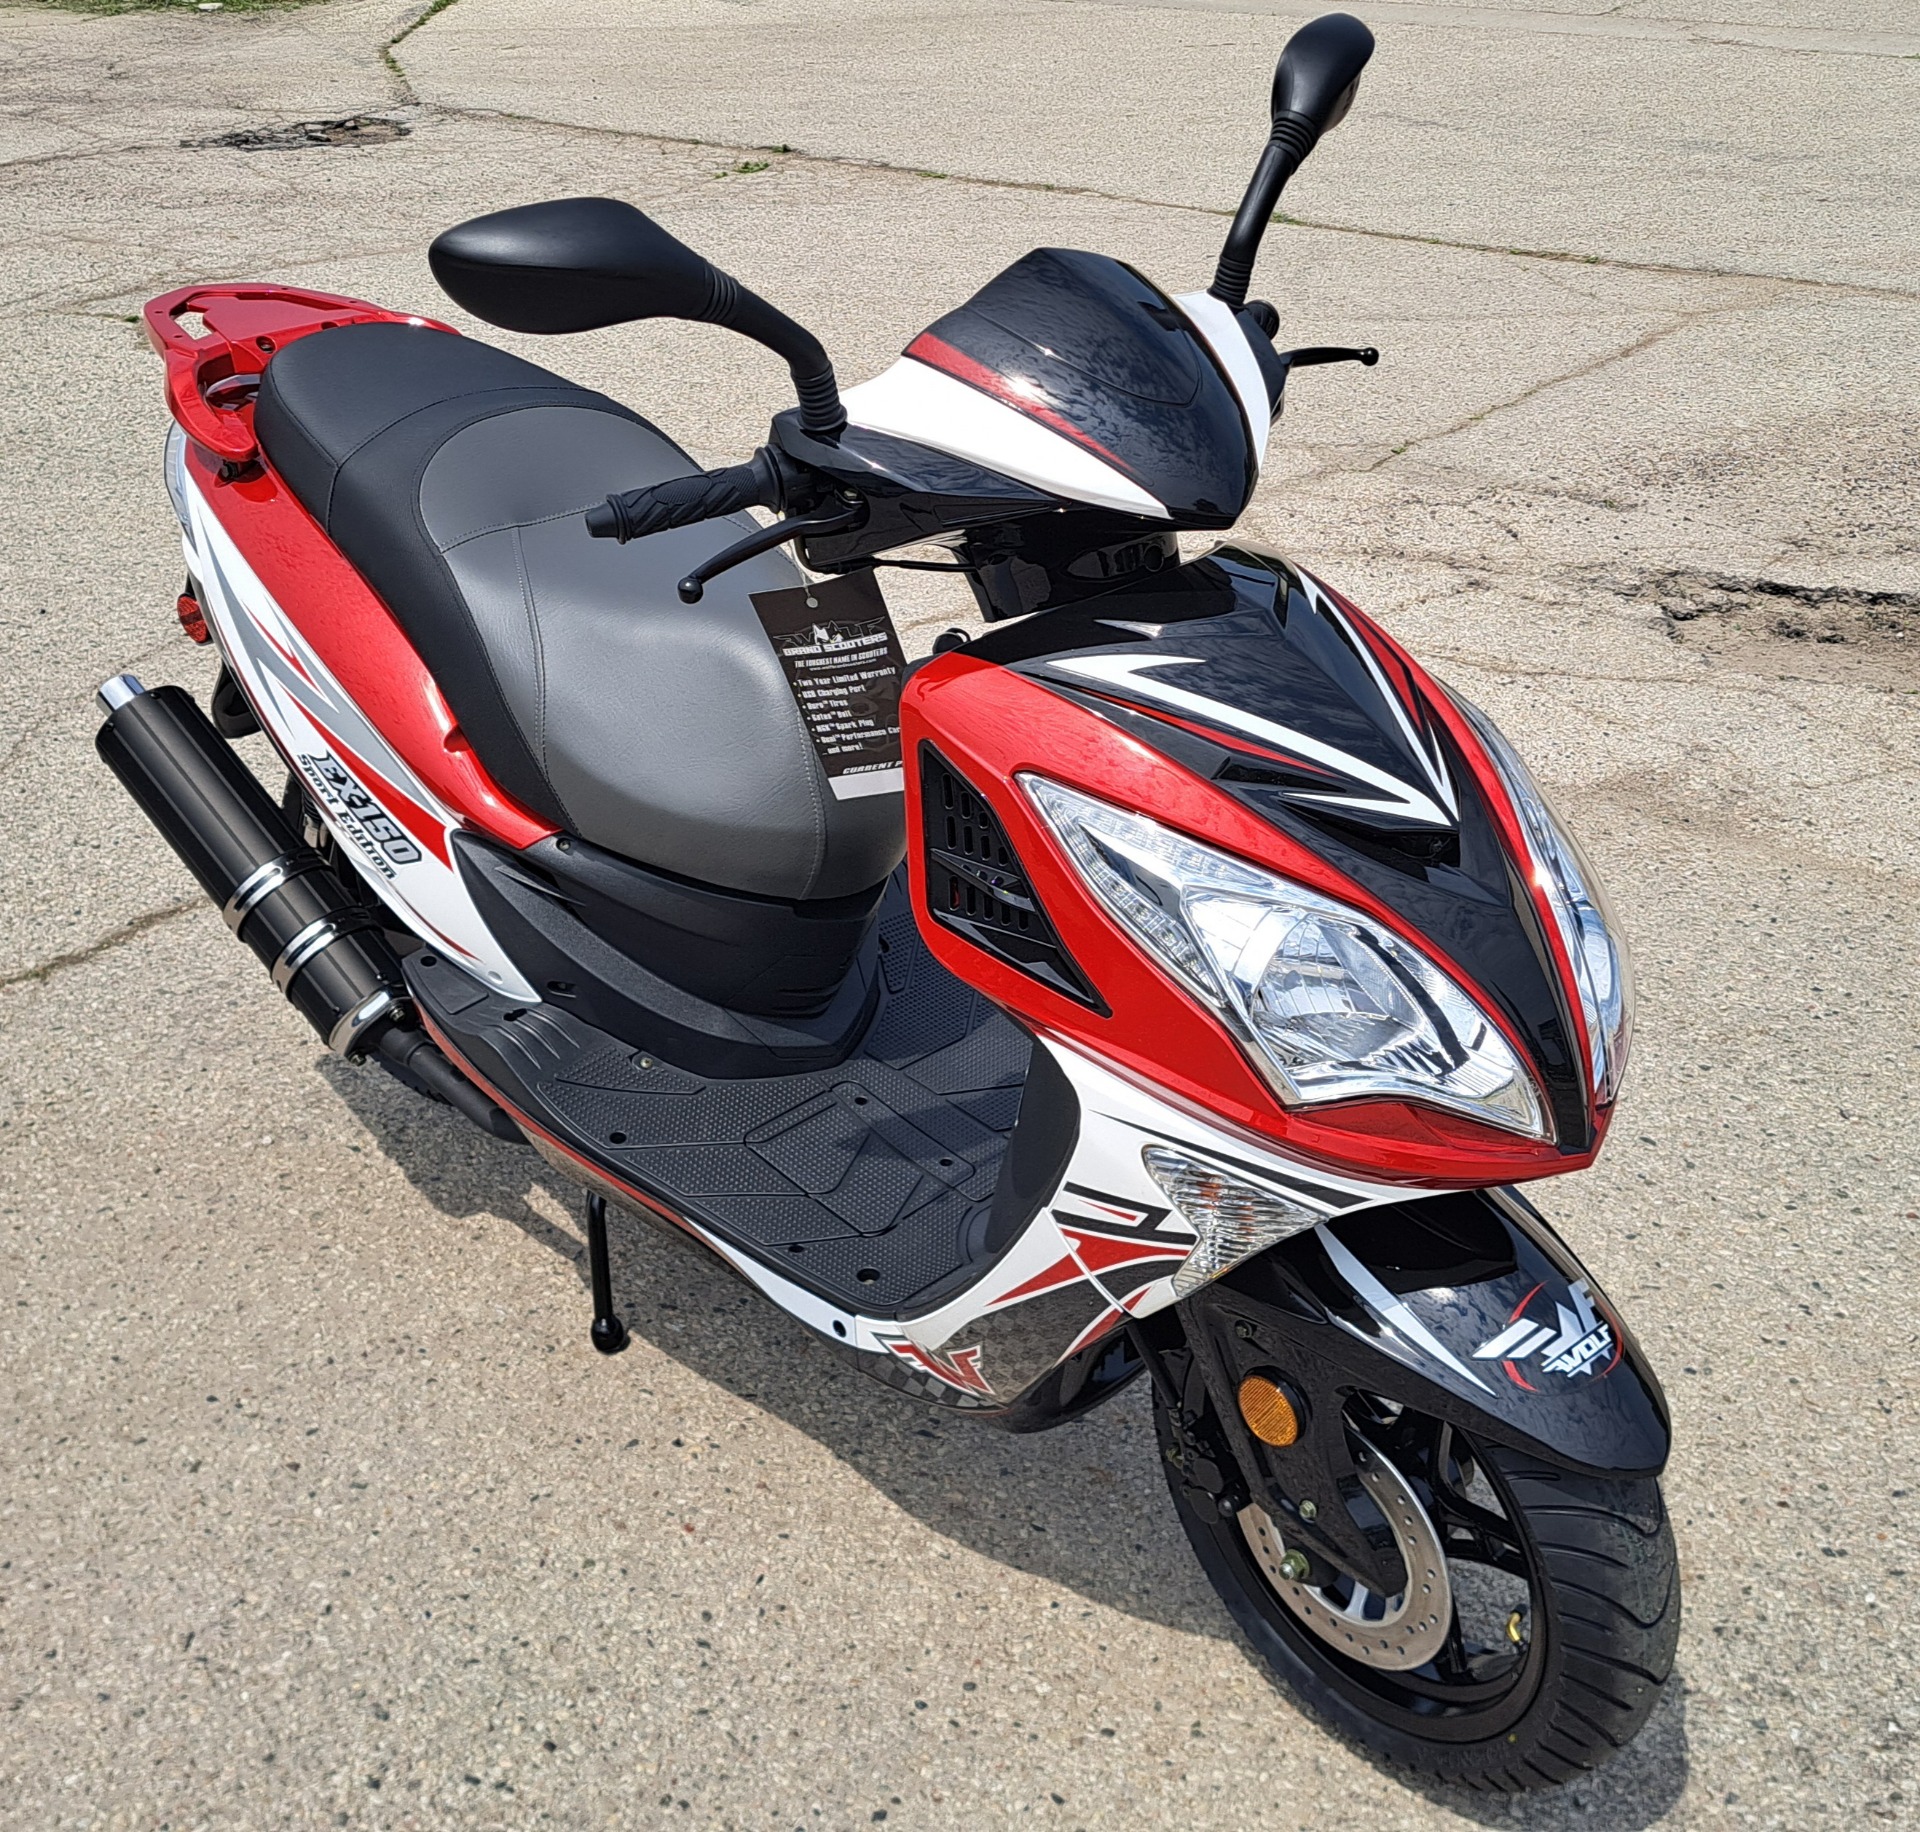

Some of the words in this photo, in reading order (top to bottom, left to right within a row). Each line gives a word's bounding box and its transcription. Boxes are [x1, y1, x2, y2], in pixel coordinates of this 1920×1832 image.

[783, 646, 822, 656] BRAND
[823, 632, 888, 652] SCOOTERS
[795, 660, 805, 668] THE
[806, 656, 833, 667] TOUGHEST
[834, 655, 851, 664] NAME
[851, 653, 858, 662] IN
[858, 646, 888, 660] SCOOTERS
[798, 678, 814, 687] Two
[814, 676, 832, 686] Year
[832, 672, 859, 684] Limited
[859, 666, 896, 680] Warranty
[817, 687, 849, 697] Charging
[849, 684, 866, 694] Port
[835, 720, 858, 731] Spark
[858, 718, 875, 728] Plug
[841, 728, 887, 741] Performance
[842, 762, 894, 775] CURRENT
[297, 753, 340, 805] Sport
[336, 809, 397, 880] Edition
[307, 749, 422, 865] EX-150
[1542, 1322, 1613, 1373] WOLF
